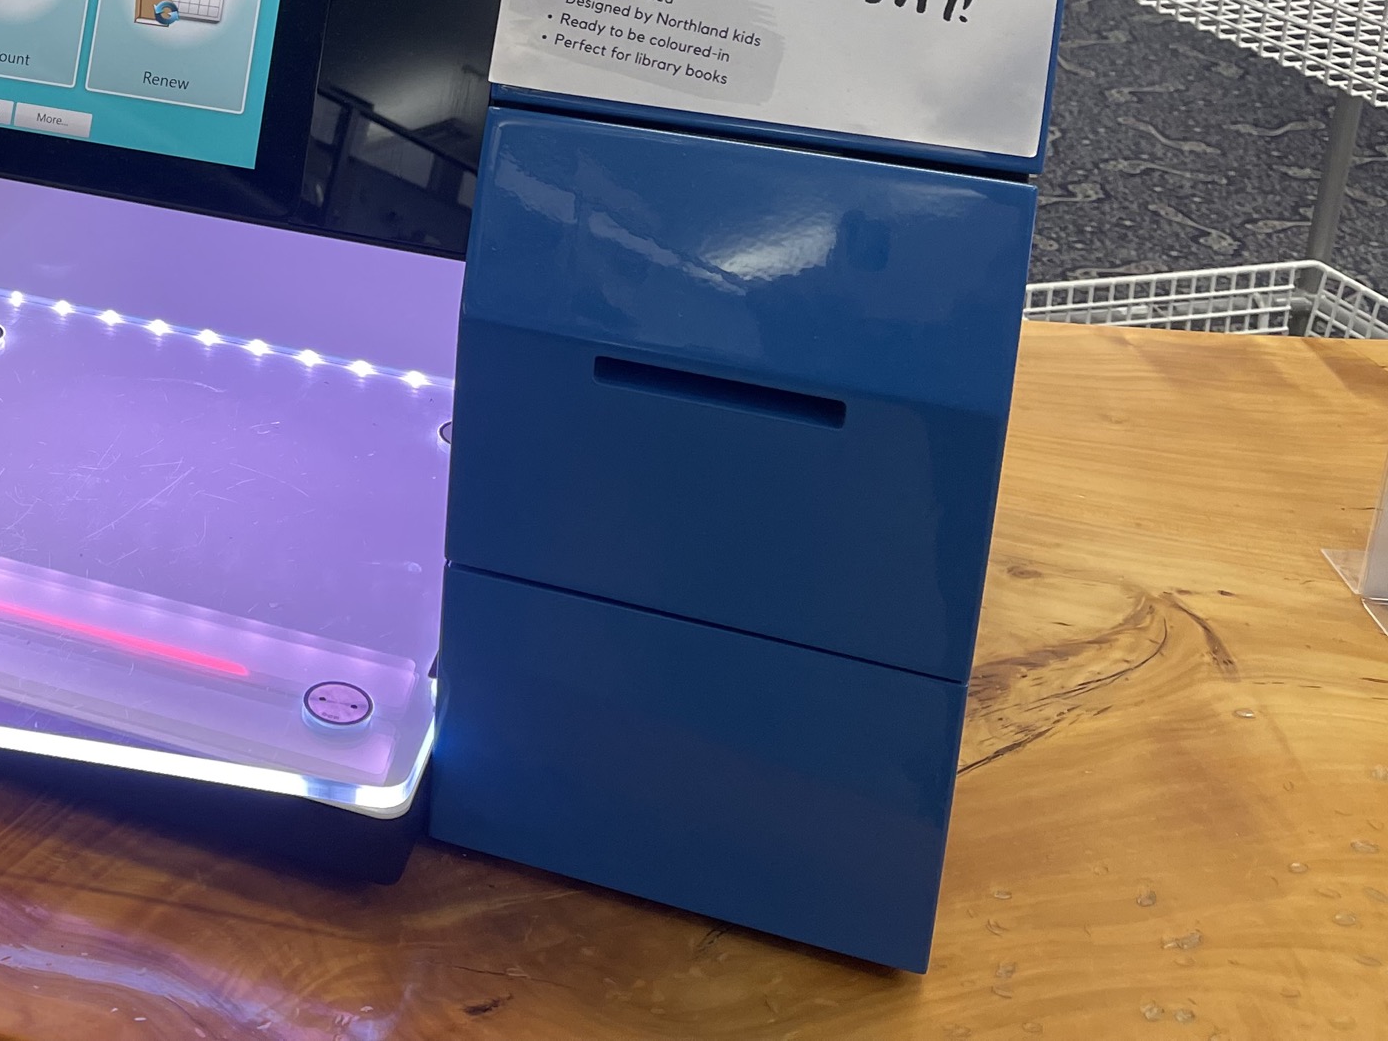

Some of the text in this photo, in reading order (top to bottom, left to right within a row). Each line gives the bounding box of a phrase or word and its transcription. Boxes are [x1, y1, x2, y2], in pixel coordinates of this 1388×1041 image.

[560, 13, 730, 63] Ready to be coloured-in
[634, 7, 653, 24] by
[656, 12, 728, 40] Northland
[732, 28, 762, 47] kids
[554, 33, 728, 85] Perfect for library books
[142, 70, 190, 91] Renew
[36, 112, 69, 127] More...
